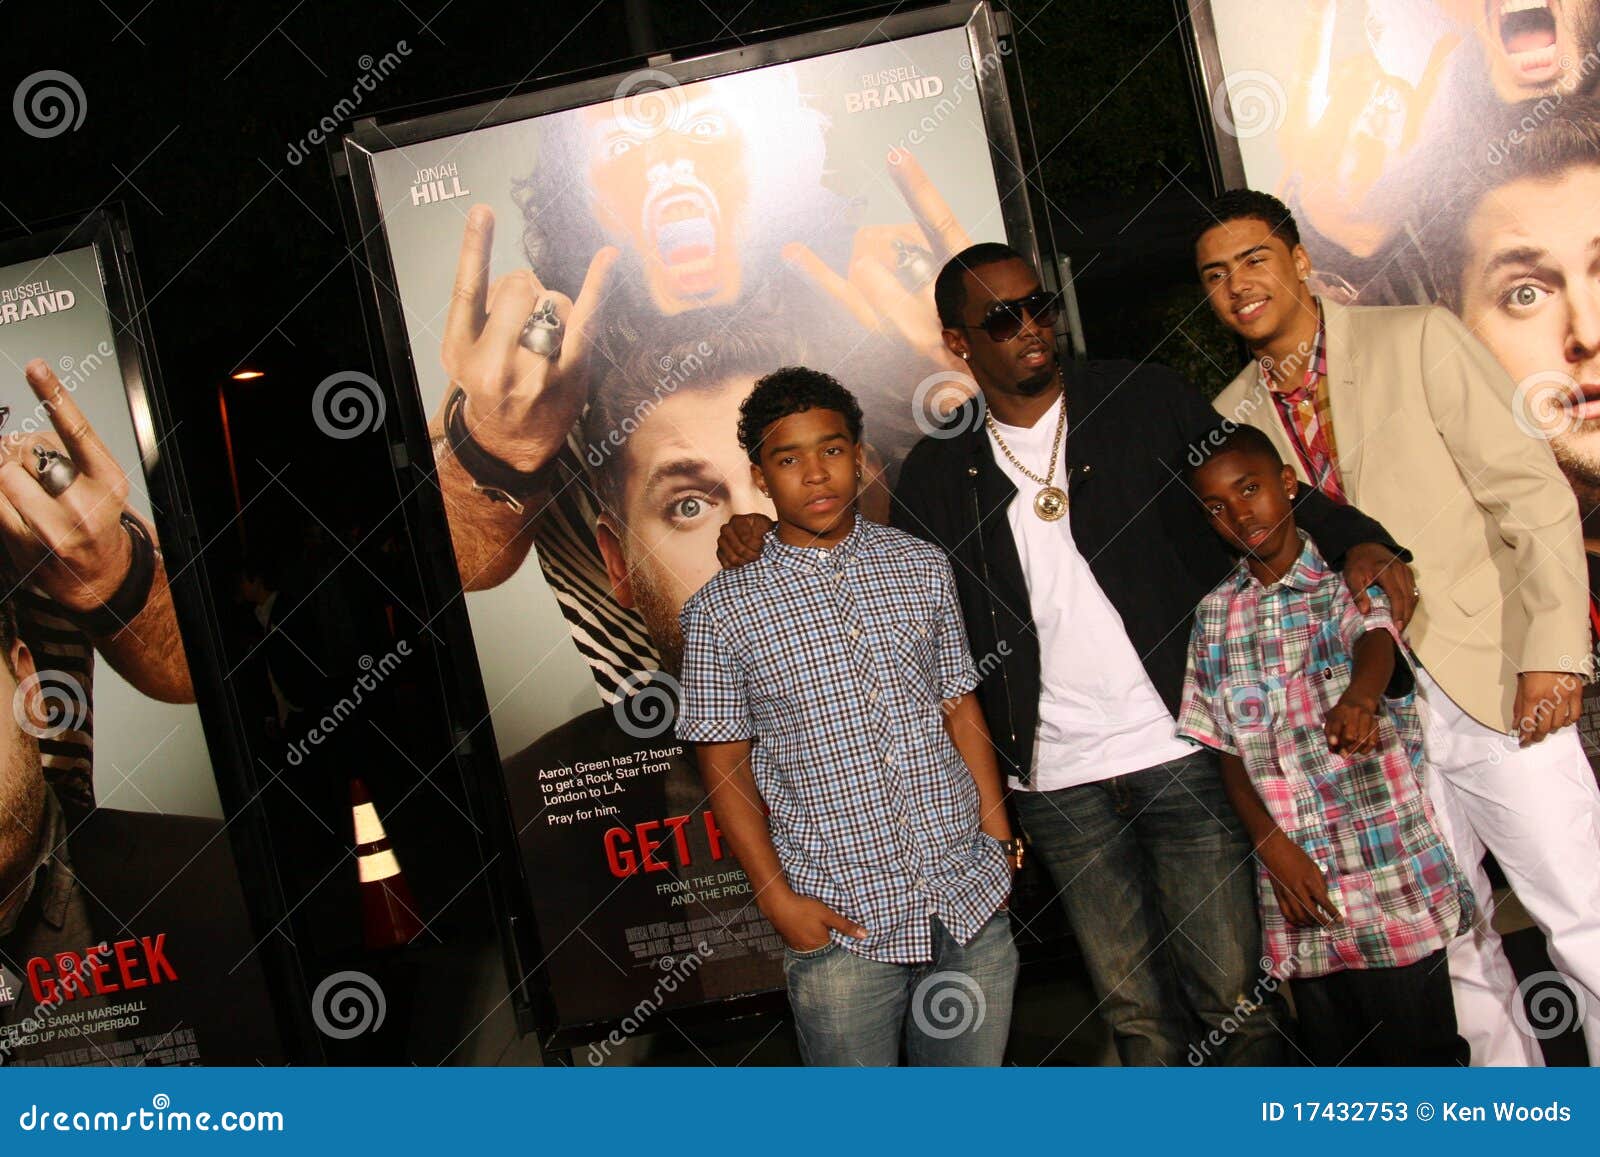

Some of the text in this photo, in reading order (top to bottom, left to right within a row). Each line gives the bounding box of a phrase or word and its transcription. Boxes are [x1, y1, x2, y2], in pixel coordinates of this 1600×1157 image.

[863, 65, 920, 89] RUSSELL
[843, 76, 945, 113] BRAND
[414, 162, 458, 184] JONAH
[410, 176, 471, 206] HILL
[2, 280, 54, 303] RUSSELL
[0, 290, 76, 324] RAND
[538, 746, 683, 780] Aaron Green has 72 hours
[541, 762, 671, 793] to get a Rock Star from
[544, 782, 626, 806] London to L.A.
[548, 805, 621, 826] Pray for him.
[603, 814, 691, 879] GET
[656, 880, 690, 895] FROM
[693, 874, 715, 889] THE
[671, 891, 696, 906] AND
[699, 887, 721, 901] THE
[26, 933, 179, 1004] GREEK
[48, 1011, 86, 1028] SARAH
[87, 1000, 147, 1020] MARSHALL
[40, 1028, 56, 1042] UP
[57, 1024, 81, 1040] AND
[83, 1015, 140, 1036] SUPERBAD
